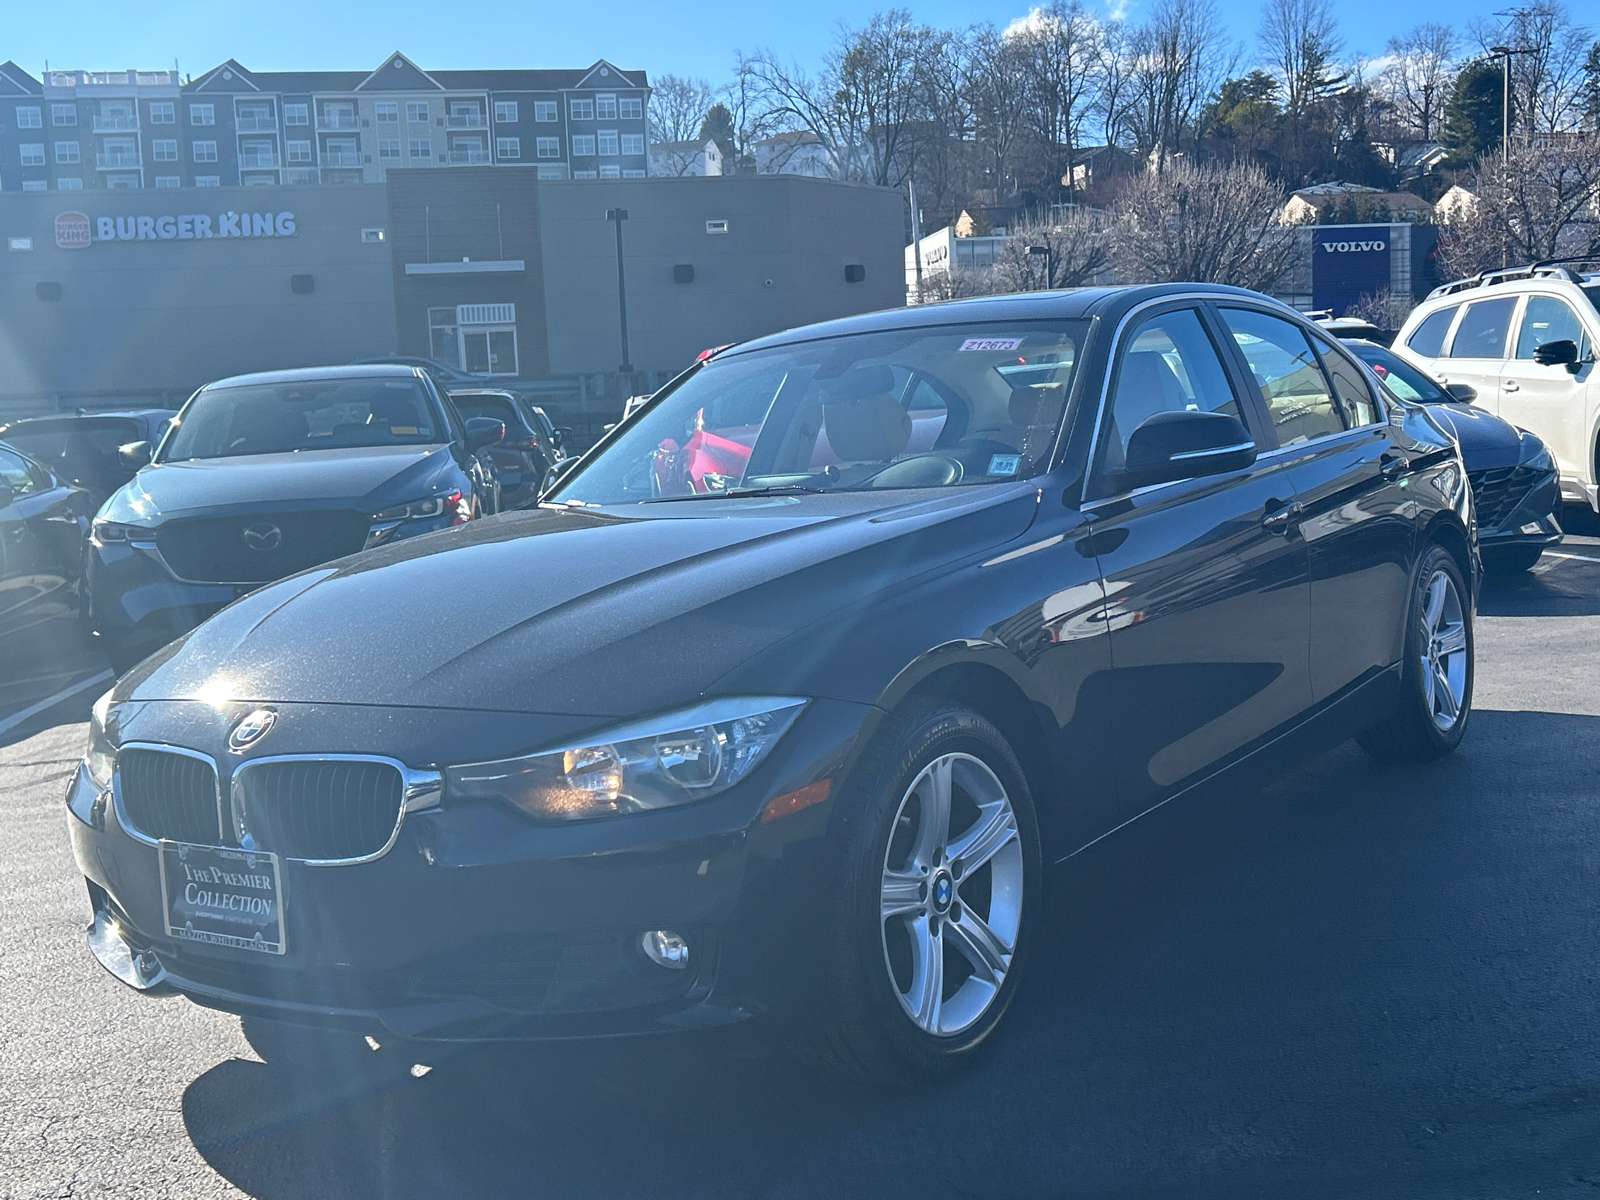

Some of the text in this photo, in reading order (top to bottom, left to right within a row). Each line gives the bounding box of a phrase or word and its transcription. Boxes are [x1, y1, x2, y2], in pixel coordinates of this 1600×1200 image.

[57, 230, 90, 241] KING
[96, 210, 296, 241] BURGER KING
[1322, 240, 1386, 253] VOLVO
[964, 341, 1015, 350] Z12673
[180, 861, 272, 890] THE PREMIER
[184, 882, 272, 916] COLLECTION
[179, 930, 269, 952] MAZDA WHITE PLAINS
